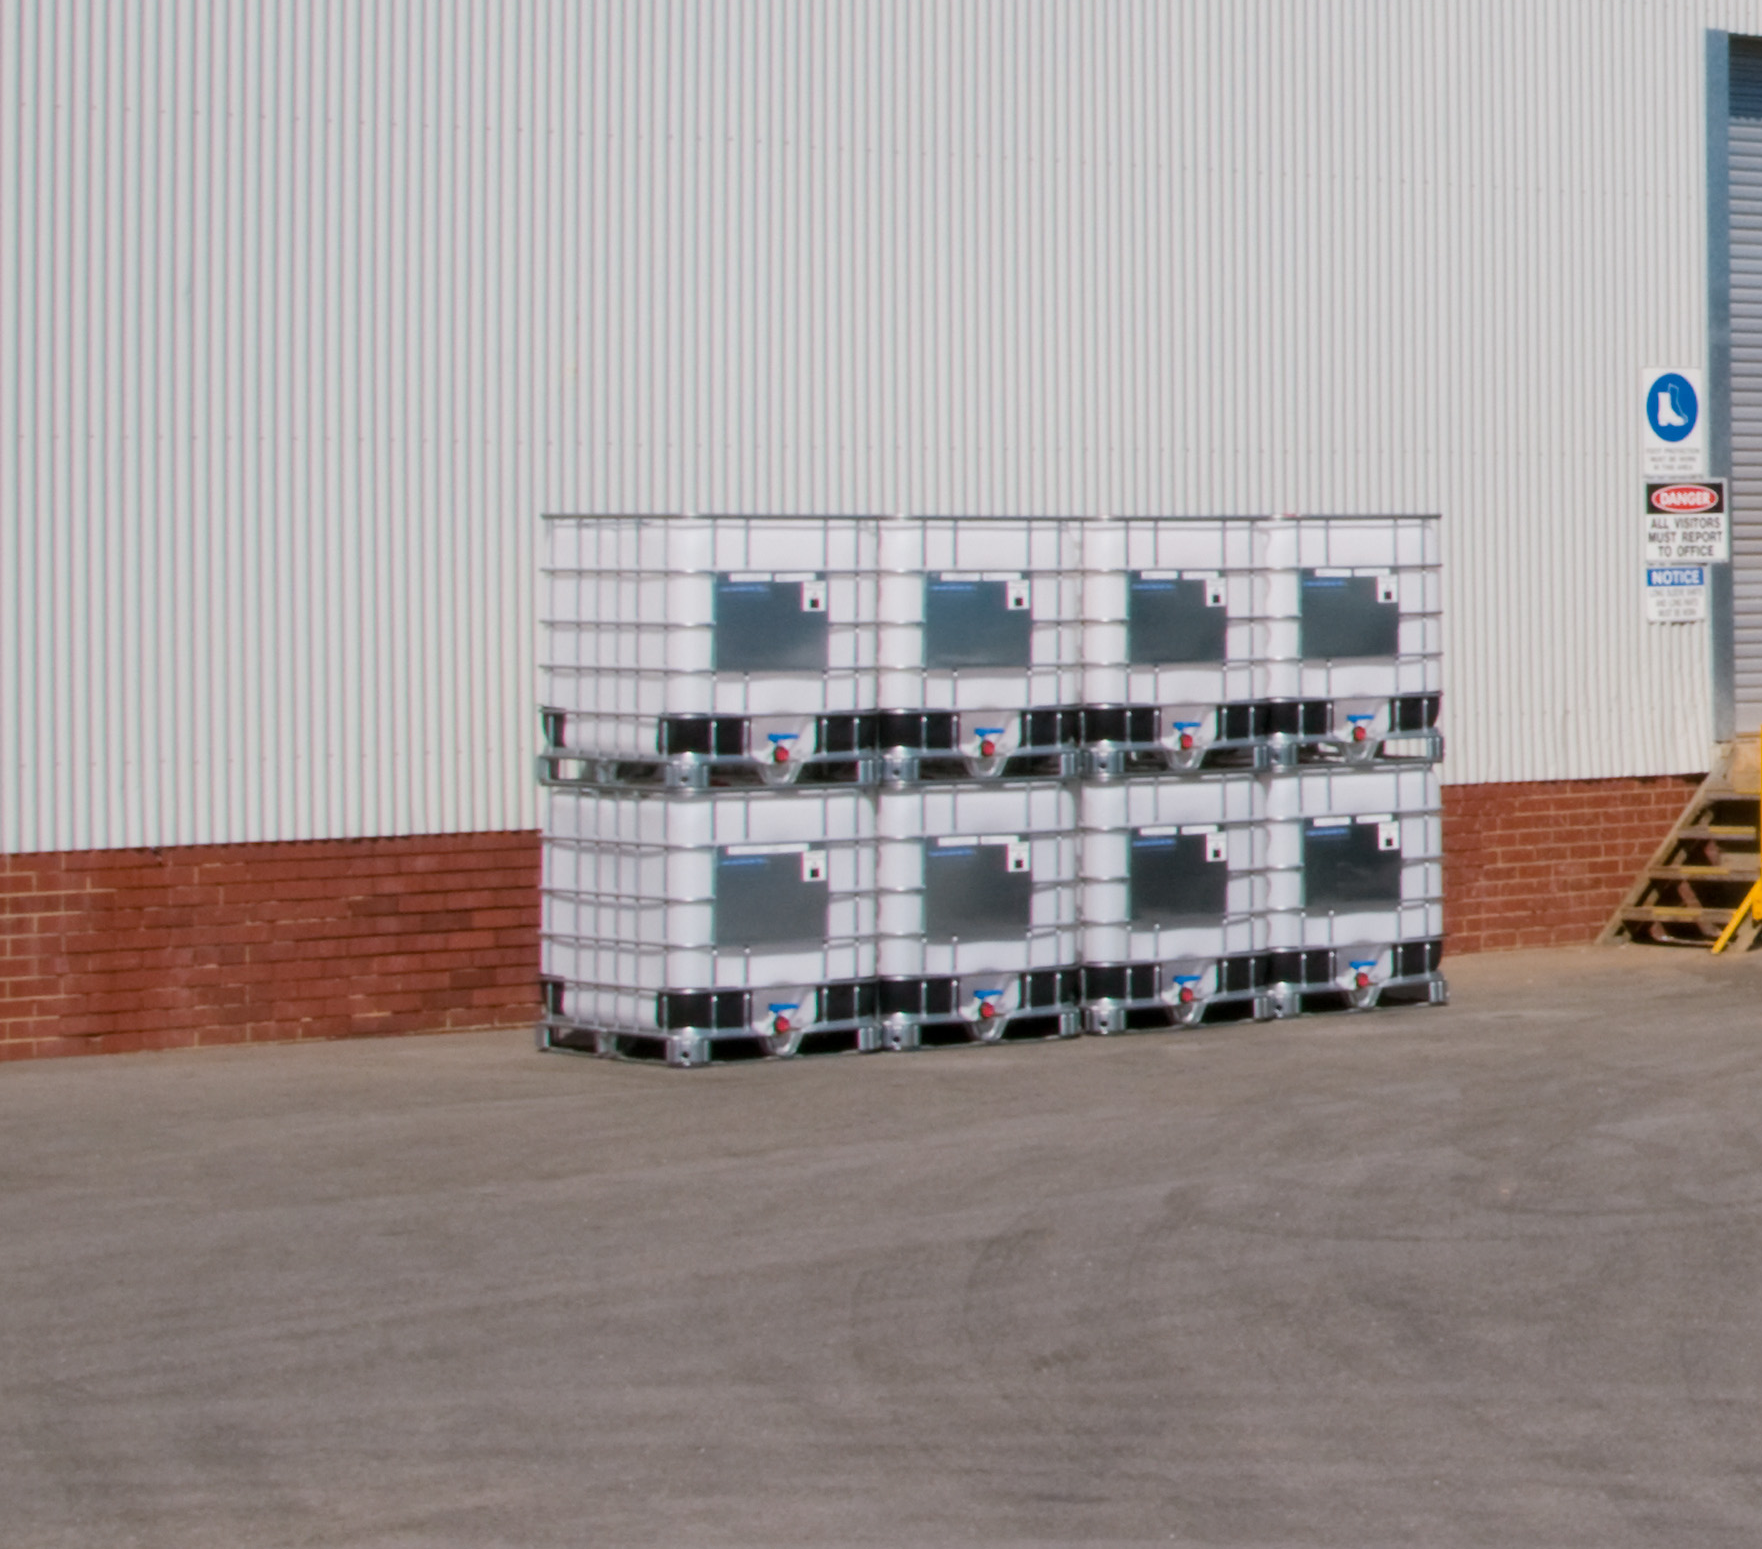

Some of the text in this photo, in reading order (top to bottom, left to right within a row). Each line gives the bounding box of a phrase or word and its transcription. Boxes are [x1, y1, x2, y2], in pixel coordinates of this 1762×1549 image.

[1660, 491, 1711, 506] DANGER
[1651, 517, 1721, 529] ALL VISITORS
[1647, 530, 1723, 543] MUST REPORT
[1658, 545, 1714, 557] TO OFFICE
[1651, 569, 1700, 584] NOTICE
